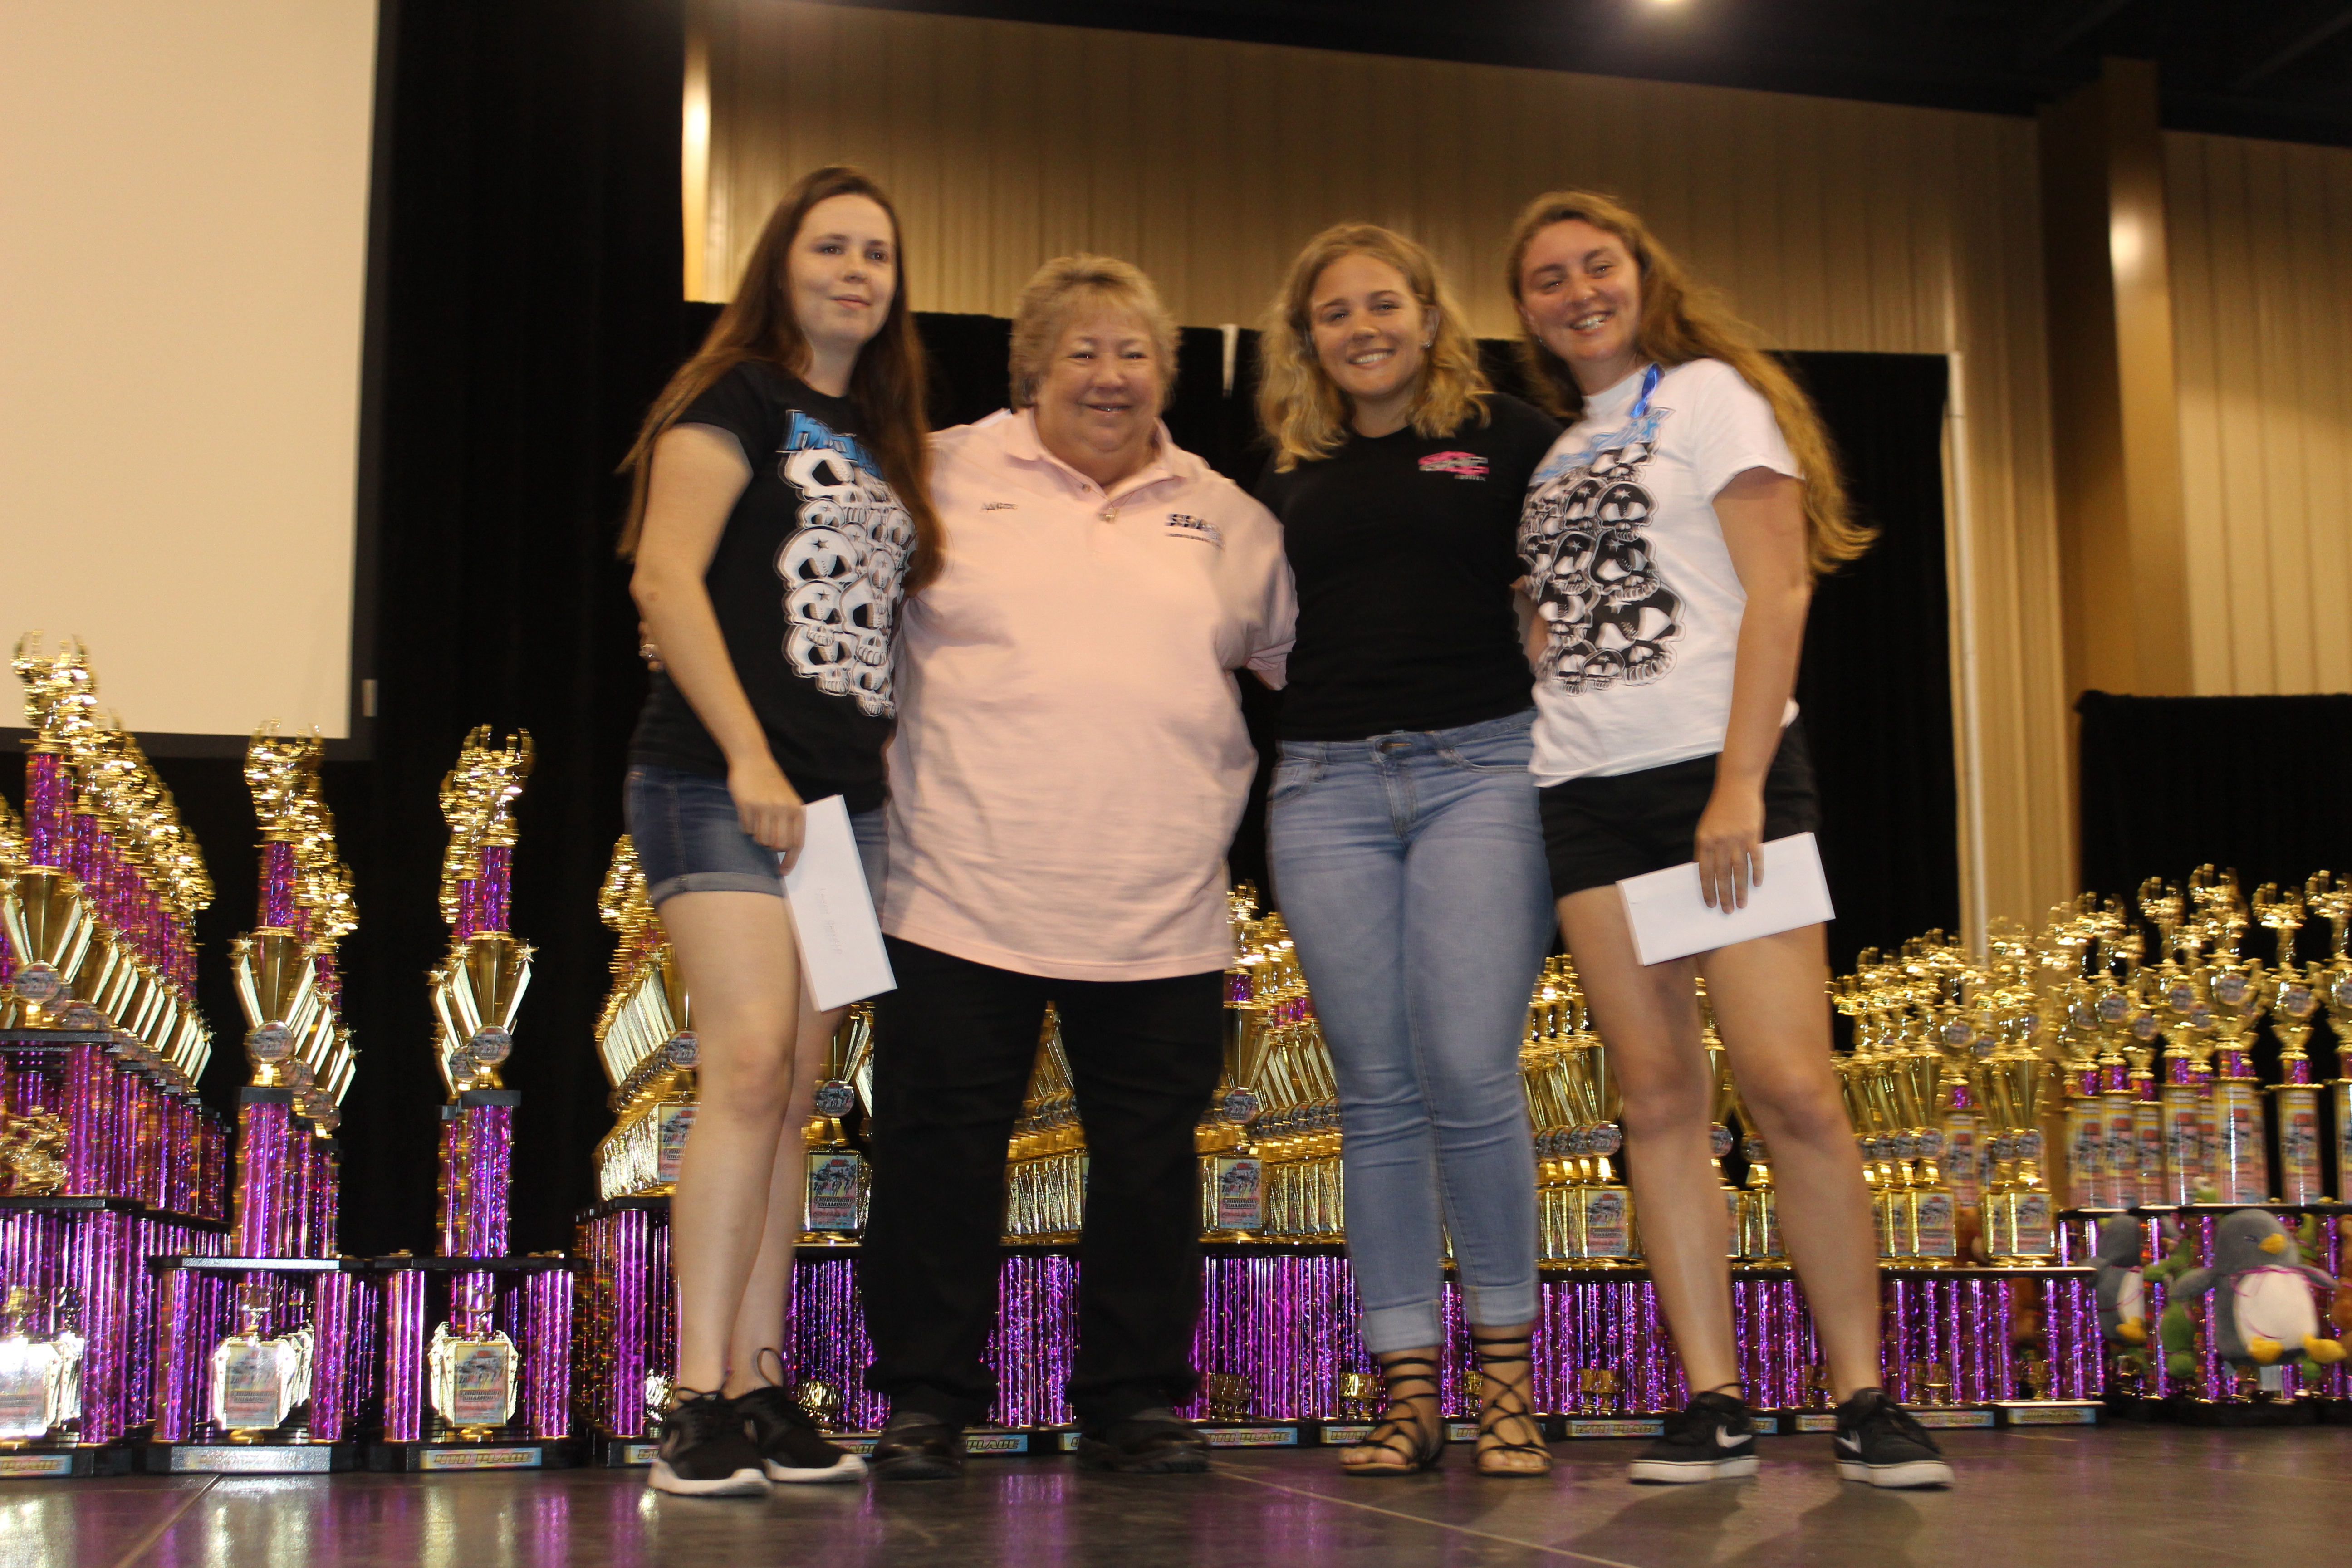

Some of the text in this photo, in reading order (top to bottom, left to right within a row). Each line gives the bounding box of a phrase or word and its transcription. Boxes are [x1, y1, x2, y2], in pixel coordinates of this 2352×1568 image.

[1240, 1432, 1291, 1442] PLACE
[966, 1439, 1020, 1450] PLACE
[434, 1452, 535, 1465] 4TH PLACE
